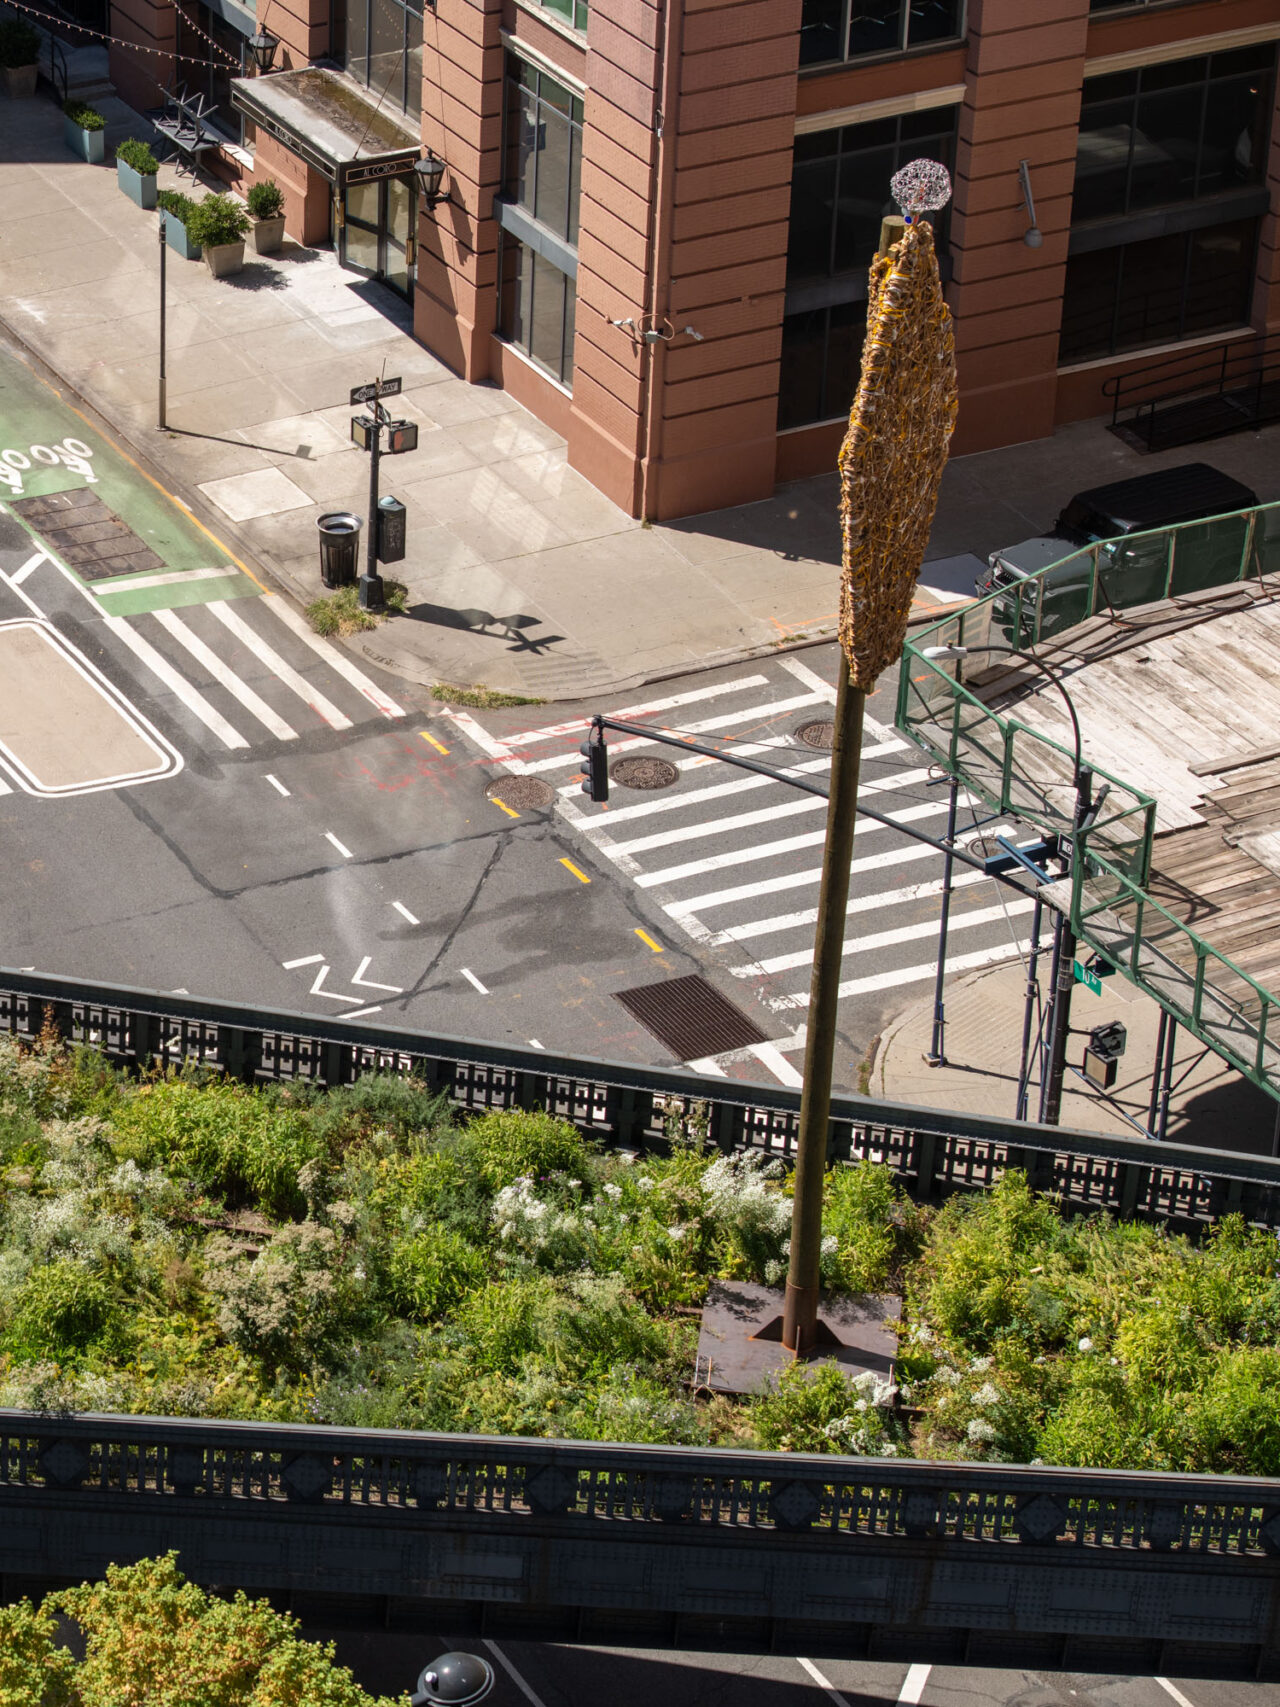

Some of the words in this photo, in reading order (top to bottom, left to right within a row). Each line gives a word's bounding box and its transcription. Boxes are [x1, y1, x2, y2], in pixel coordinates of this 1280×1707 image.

[358, 388, 372, 399] ONE
[381, 383, 396, 393] WAY
[1083, 968, 1090, 985] 10
